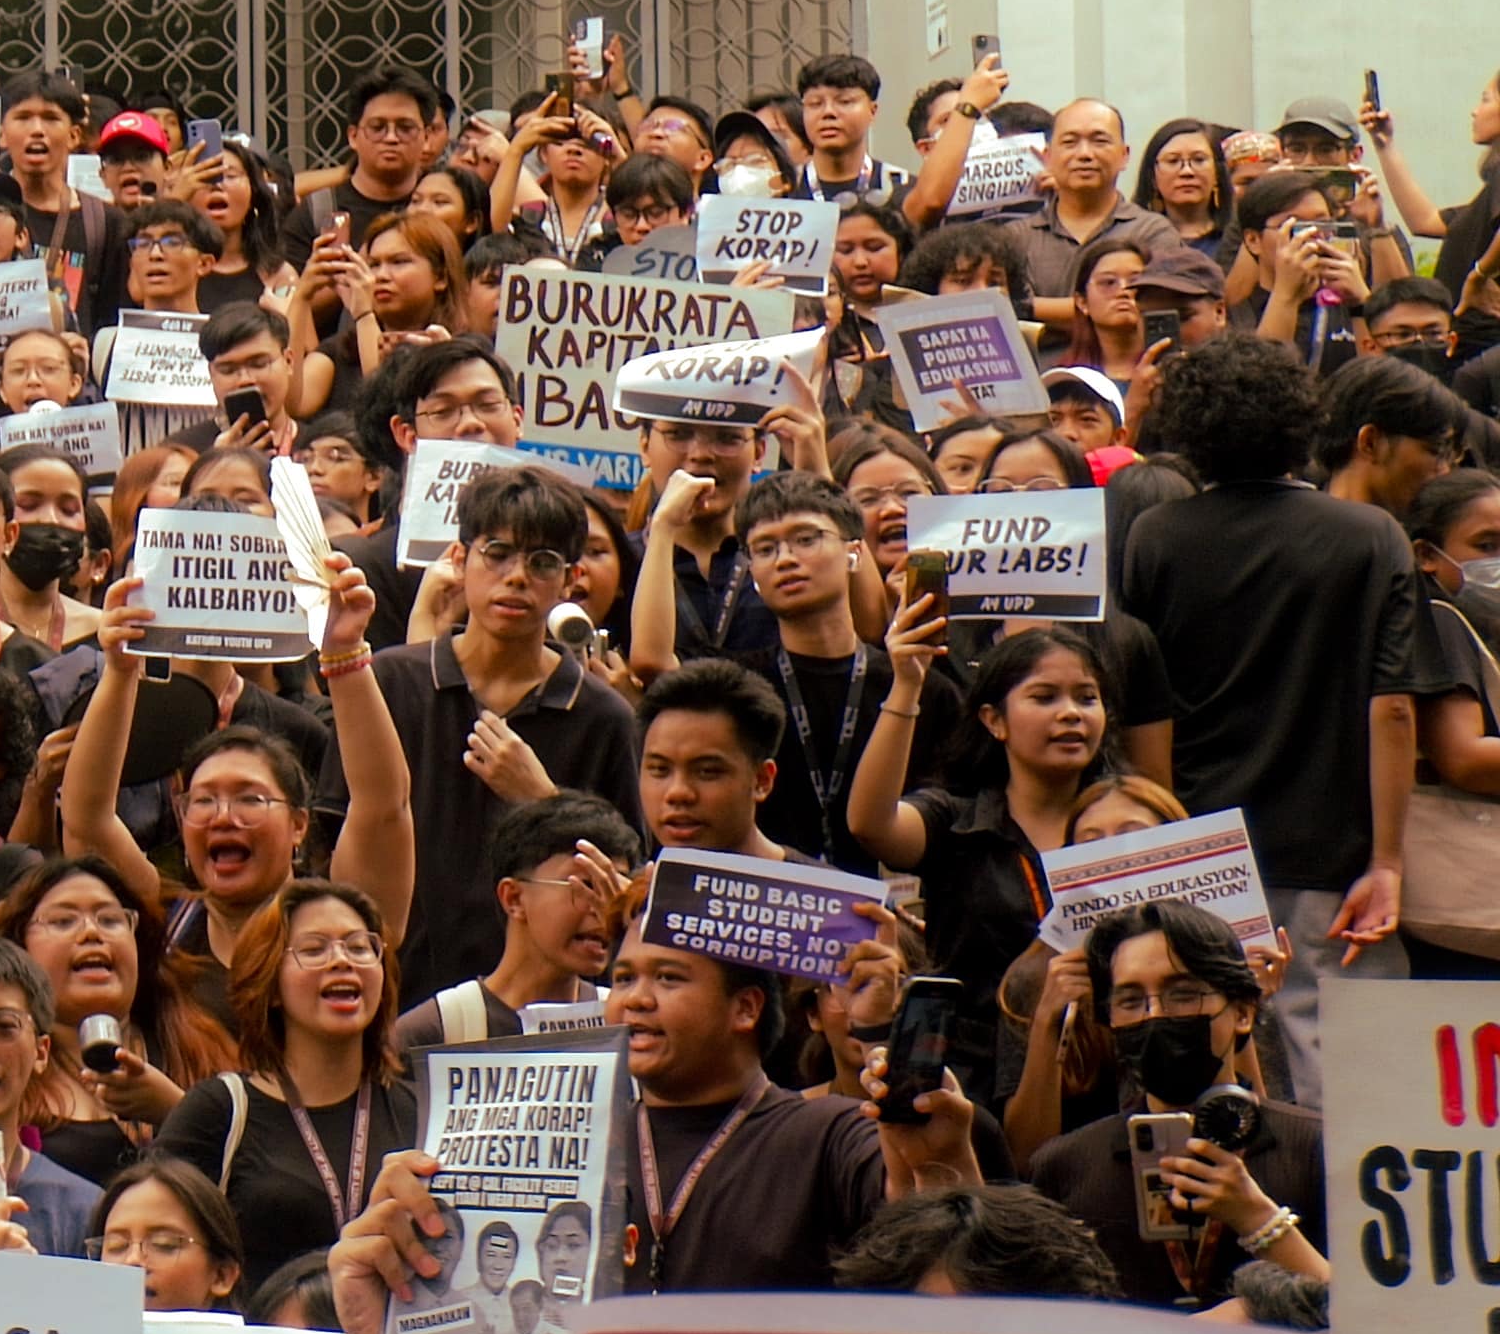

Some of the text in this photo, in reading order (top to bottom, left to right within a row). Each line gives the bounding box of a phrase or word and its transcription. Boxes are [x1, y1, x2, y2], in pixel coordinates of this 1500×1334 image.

[736, 210, 803, 235] STOP
[716, 236, 819, 266] KORAP!
[918, 326, 990, 348] SAPAT NA
[925, 346, 998, 367] PONDO SA
[963, 517, 1052, 548] FUND
[999, 541, 1087, 579] LABS!
[693, 872, 843, 918] FUND BASIC
[707, 897, 823, 933] STUDENT
[665, 913, 801, 955] SERVICES,
[671, 932, 842, 981] CORRUPTION!
[448, 1066, 598, 1105] PANAGUTIN
[444, 1106, 592, 1133] ANG MGA KORAP!
[438, 1135, 589, 1170] PROTESTA NA!
